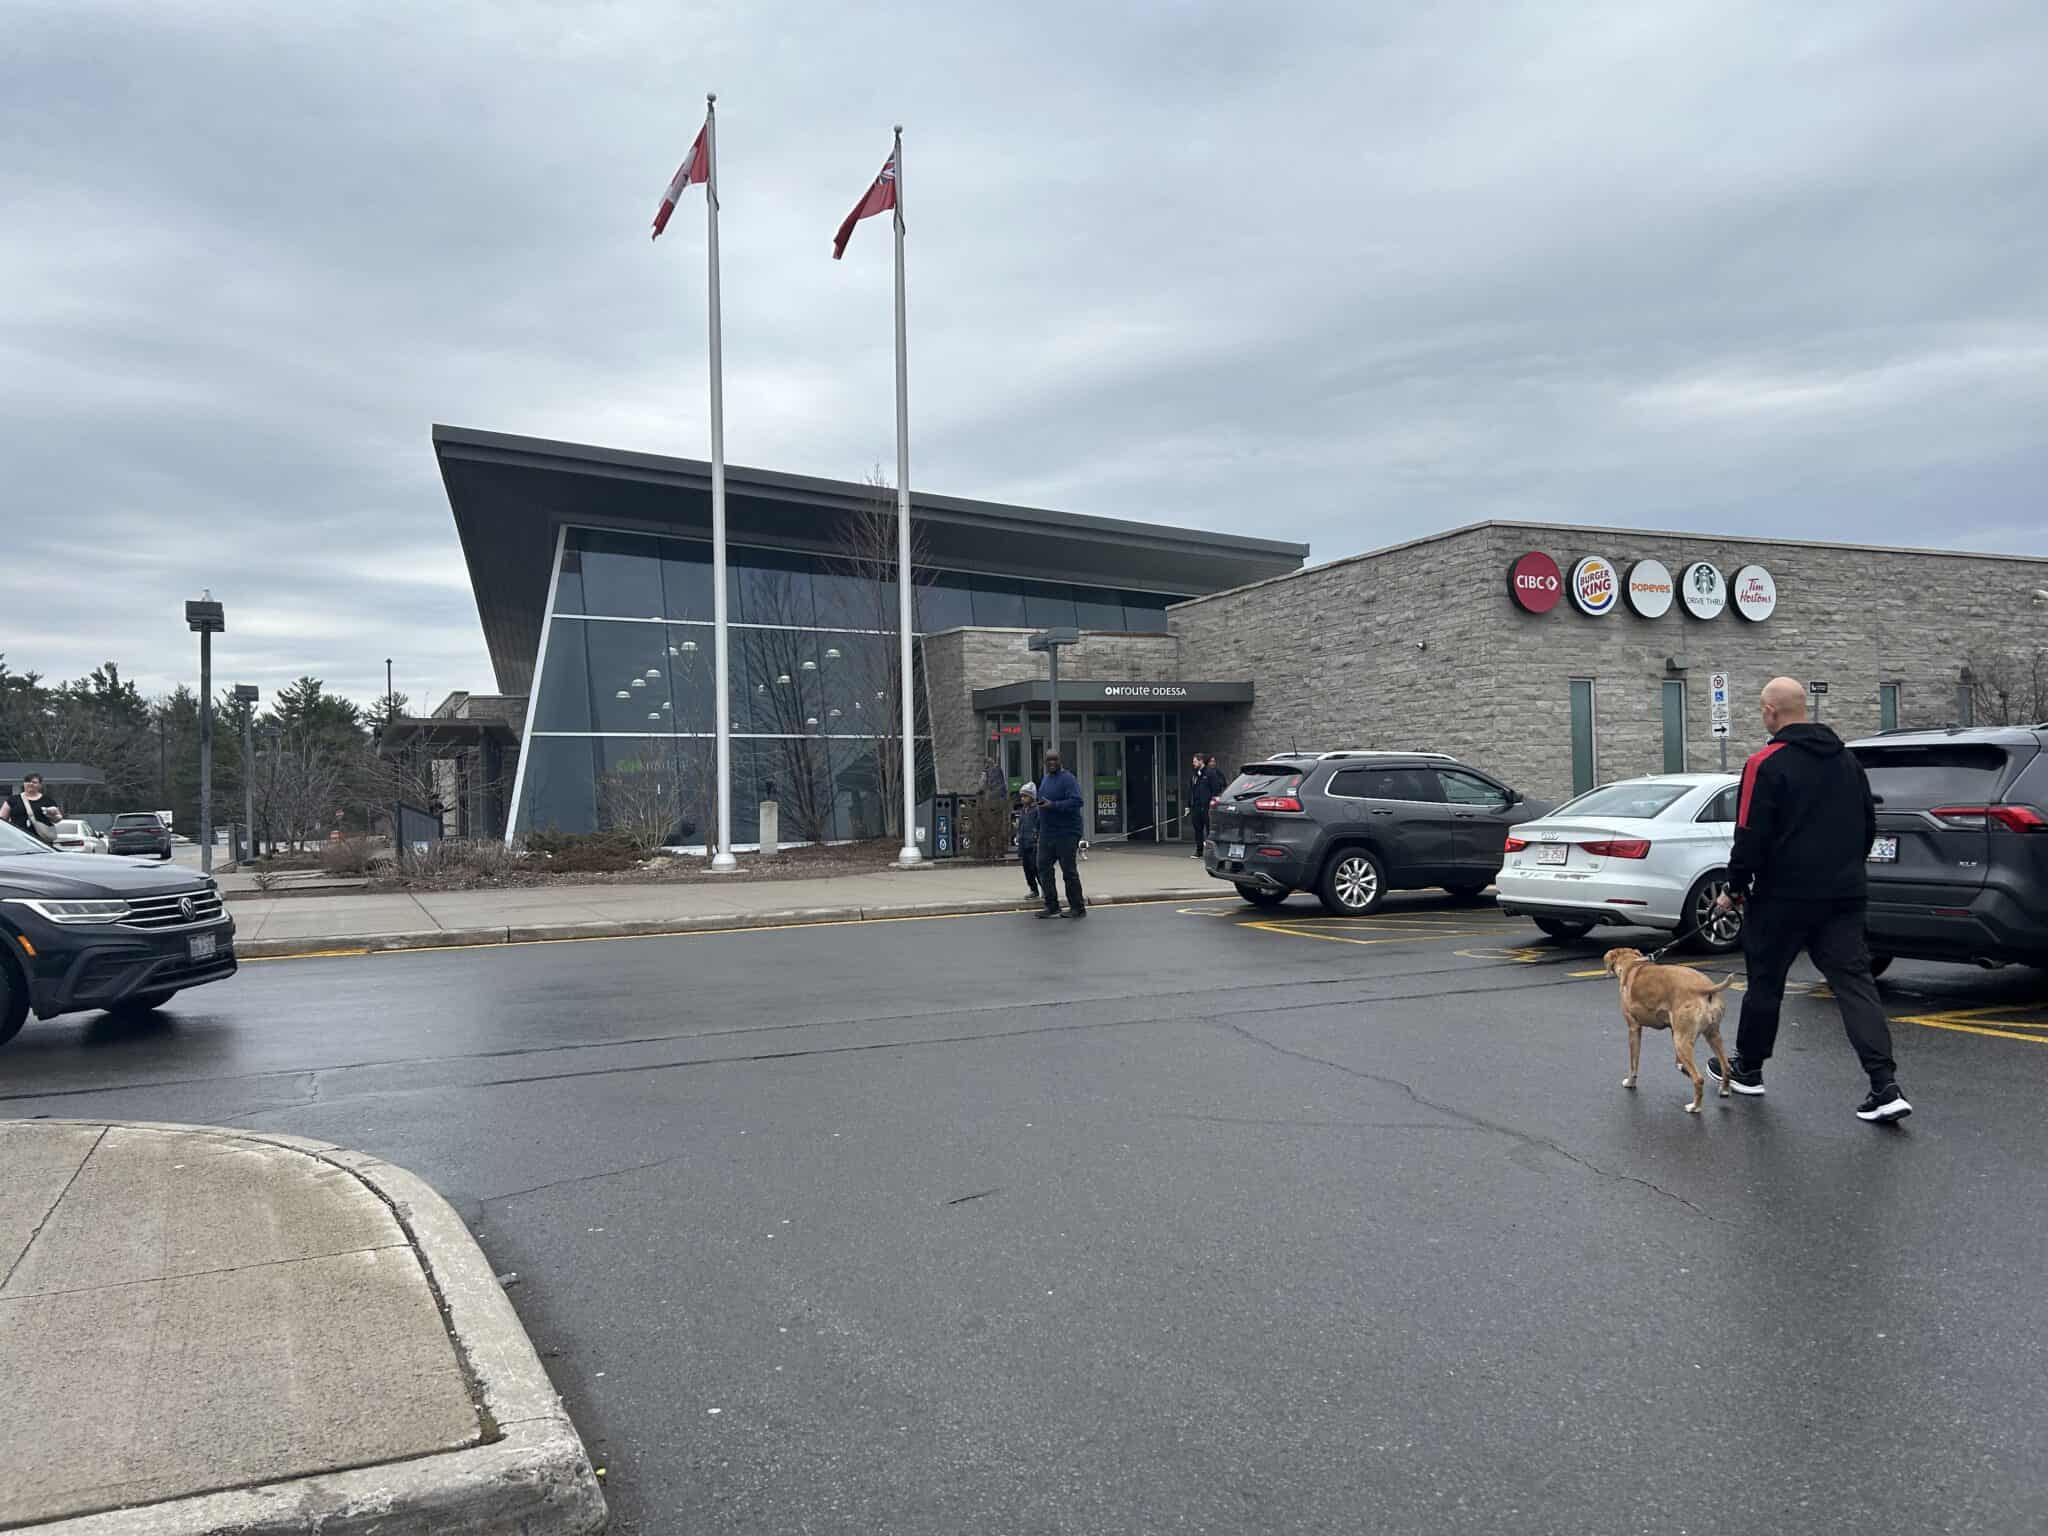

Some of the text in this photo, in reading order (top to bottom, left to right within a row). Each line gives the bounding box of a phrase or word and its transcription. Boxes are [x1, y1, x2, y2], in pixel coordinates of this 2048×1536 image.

[1516, 574, 1545, 590] CIBC
[1580, 569, 1609, 585] BURGER
[1746, 578, 1763, 591] Tim
[1582, 578, 1611, 598] KING
[1740, 589, 1771, 603] Hortons
[1152, 687, 1187, 696] ODESSA
